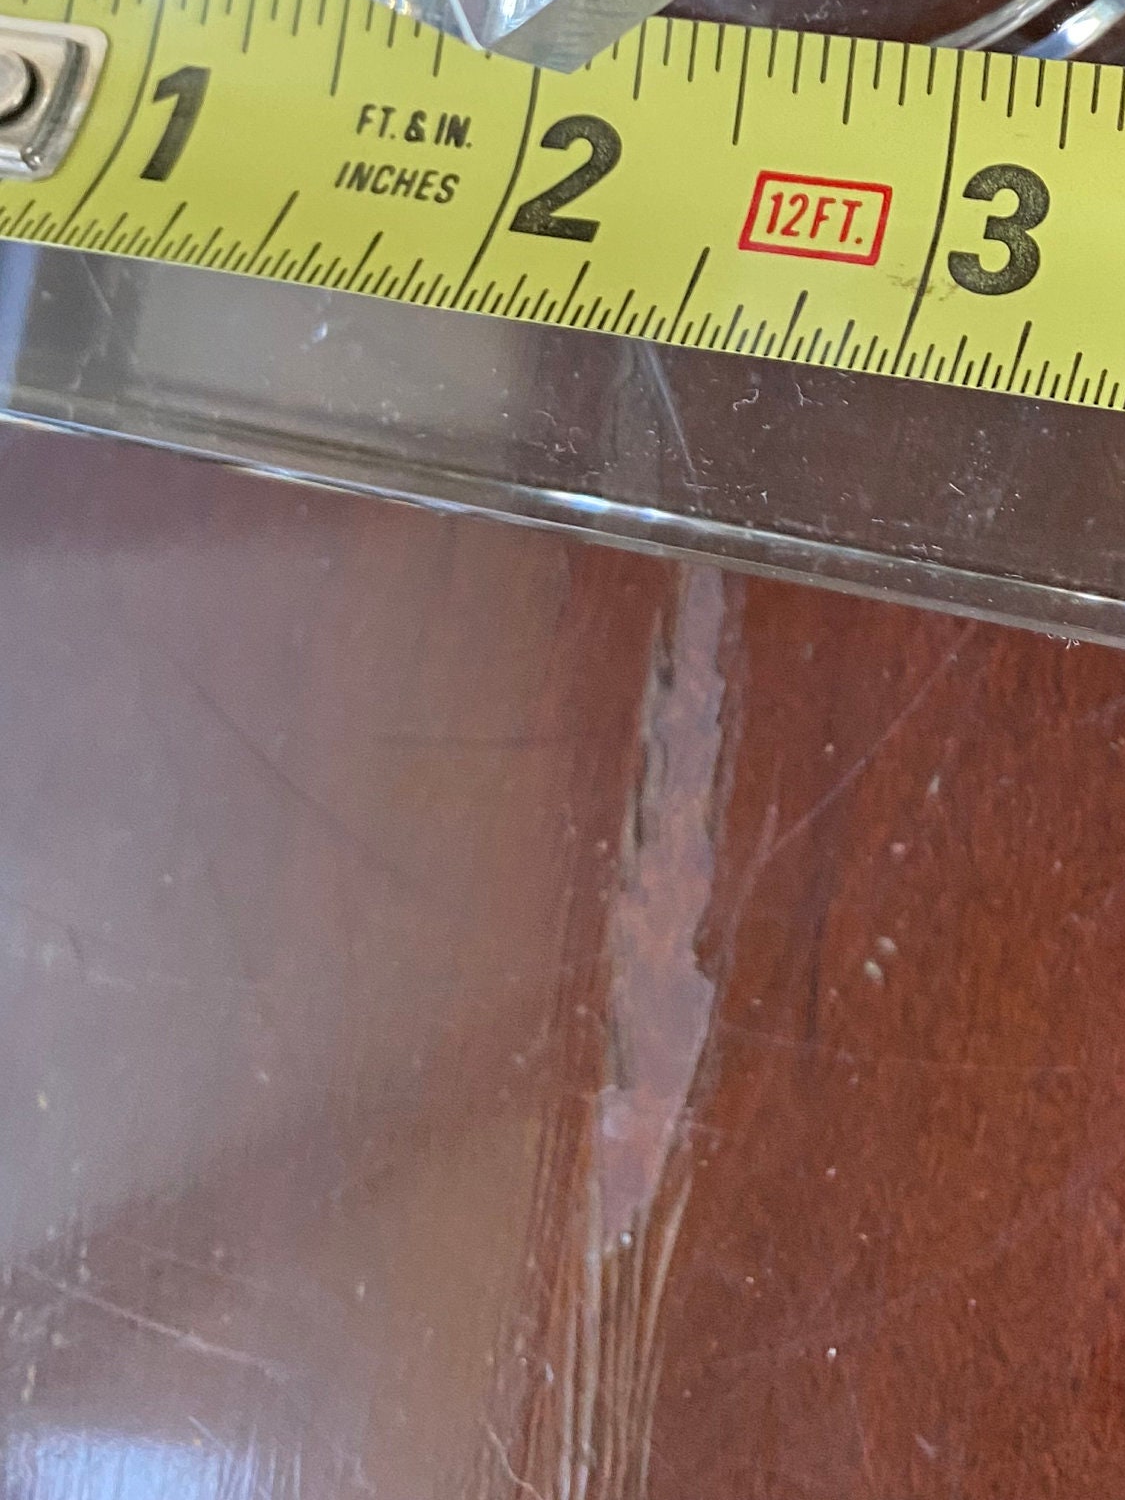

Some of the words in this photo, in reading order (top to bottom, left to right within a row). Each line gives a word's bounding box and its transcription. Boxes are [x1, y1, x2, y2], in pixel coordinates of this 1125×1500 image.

[139, 65, 213, 182] 1
[356, 103, 396, 139] FT.
[404, 109, 427, 142] &
[433, 112, 472, 149] IN.
[334, 161, 460, 204] INCHES
[509, 114, 623, 243] 2
[765, 191, 864, 245] 12FT.
[947, 163, 1051, 295] 3
